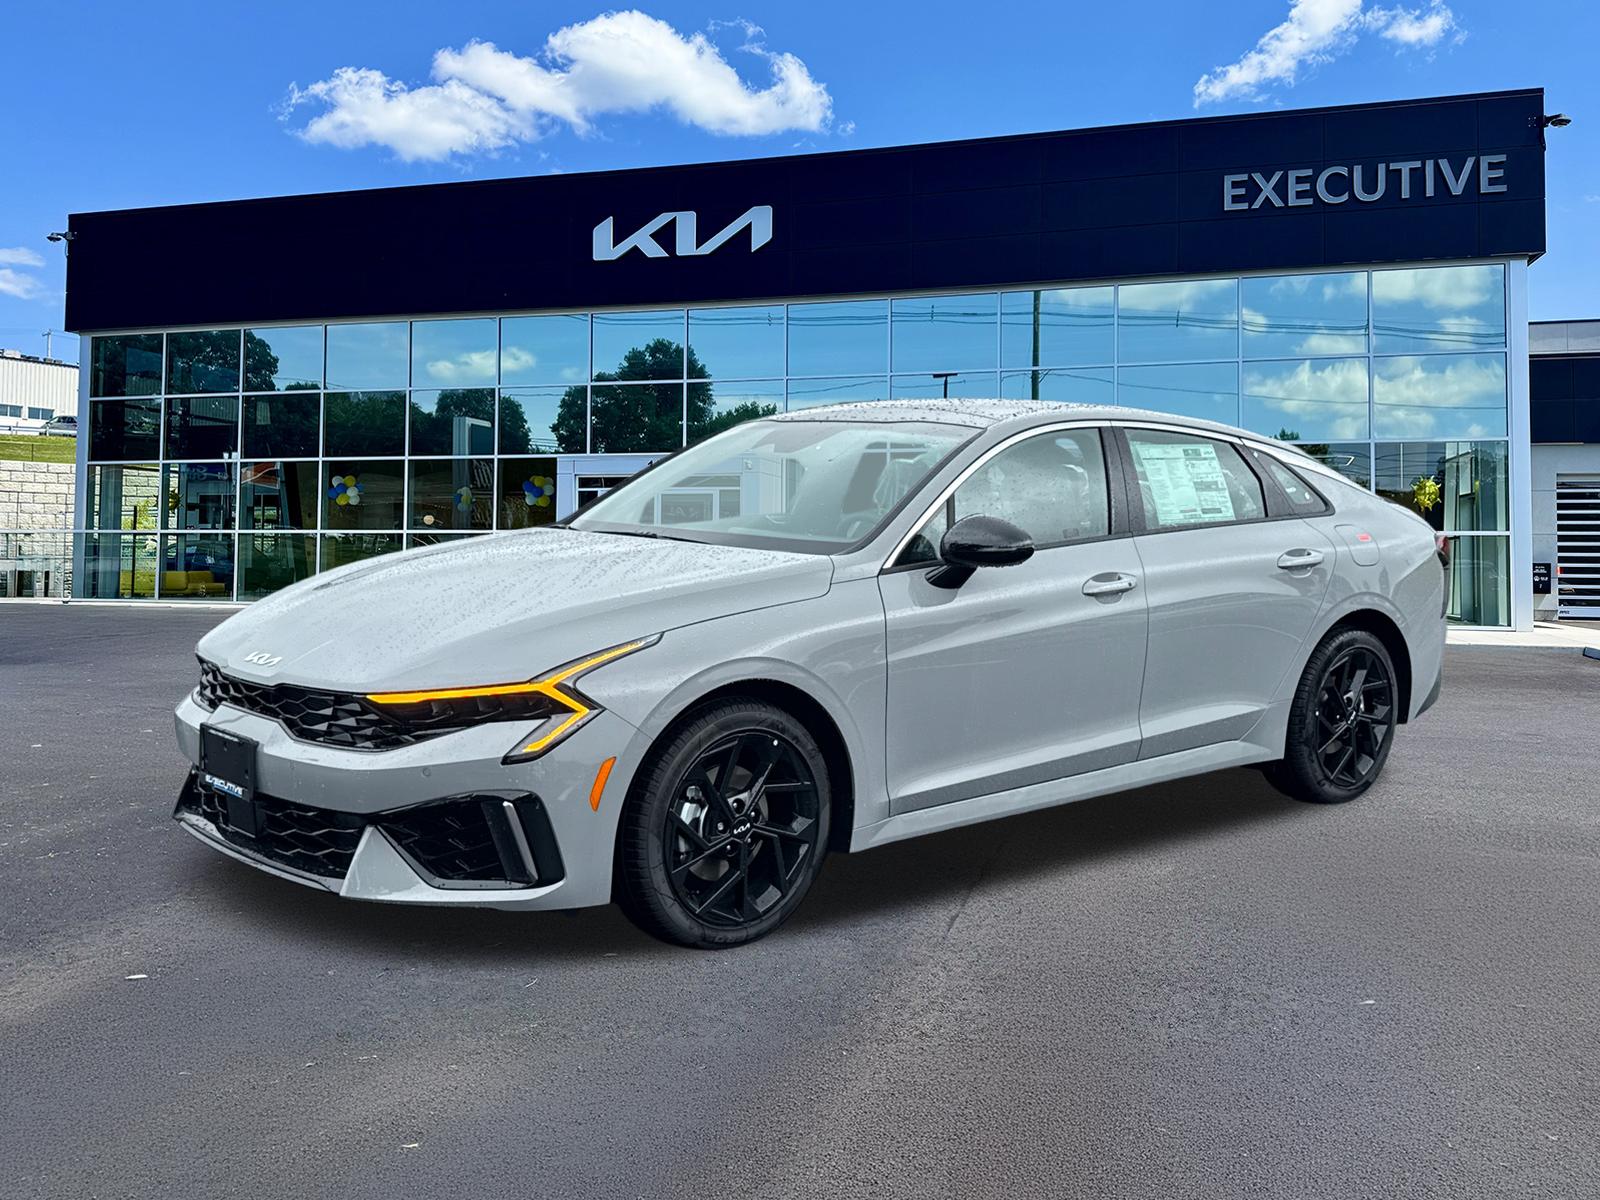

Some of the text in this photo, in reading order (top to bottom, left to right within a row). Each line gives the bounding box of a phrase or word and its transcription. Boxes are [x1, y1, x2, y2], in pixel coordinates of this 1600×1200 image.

[1223, 154, 1508, 211] EXECUTIVE
[592, 204, 773, 261] KIA
[244, 650, 282, 667] KIA
[733, 822, 751, 835] KIA
